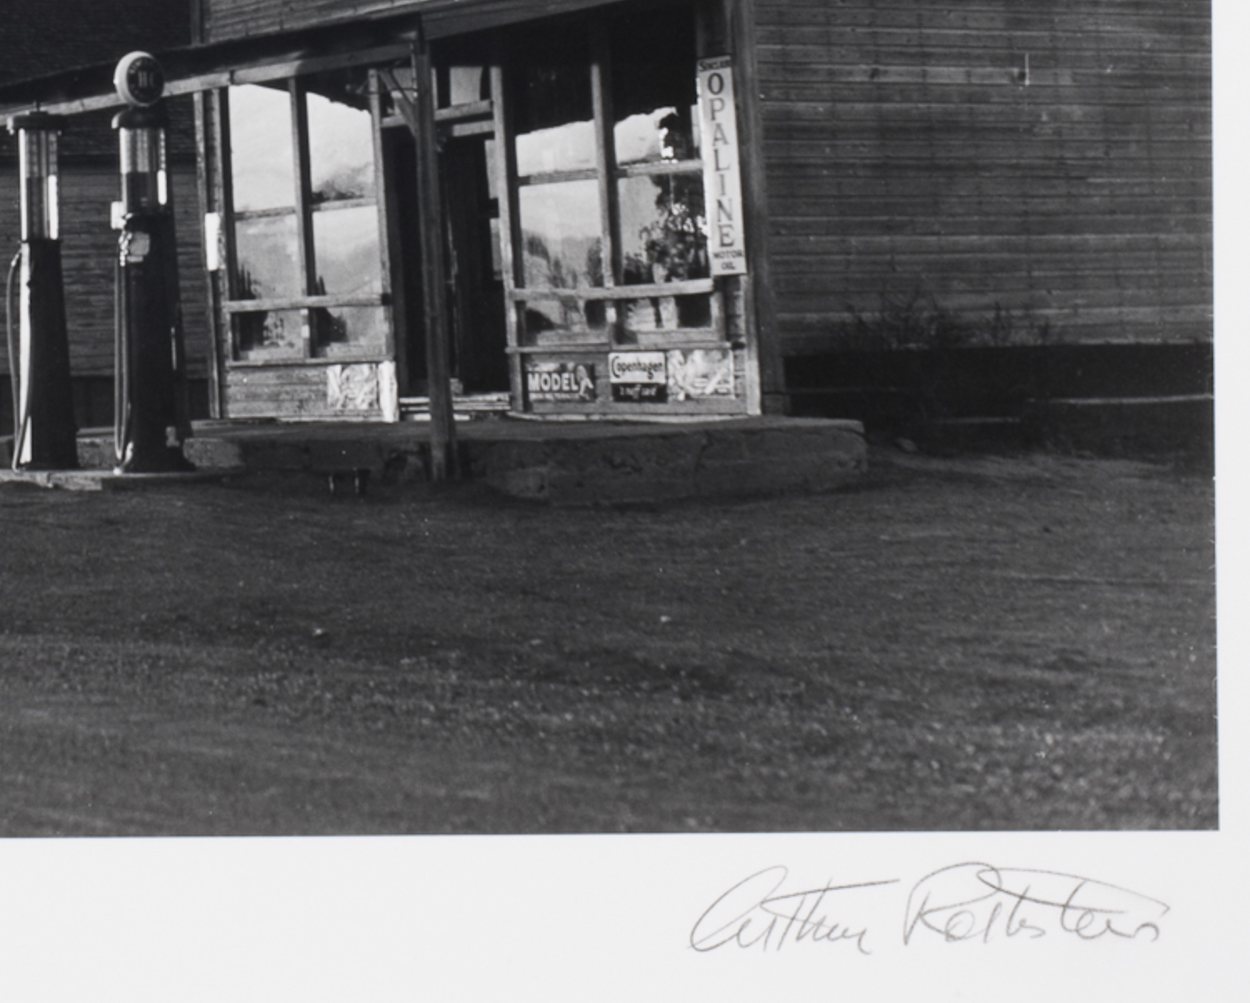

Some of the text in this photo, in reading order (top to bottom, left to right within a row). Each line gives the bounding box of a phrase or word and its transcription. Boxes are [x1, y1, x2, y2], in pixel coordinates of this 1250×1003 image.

[707, 72, 735, 247] OPALINE
[713, 249, 743, 259] MOTOR
[611, 355, 664, 380] Copenhagen
[527, 372, 579, 392] MODEL
